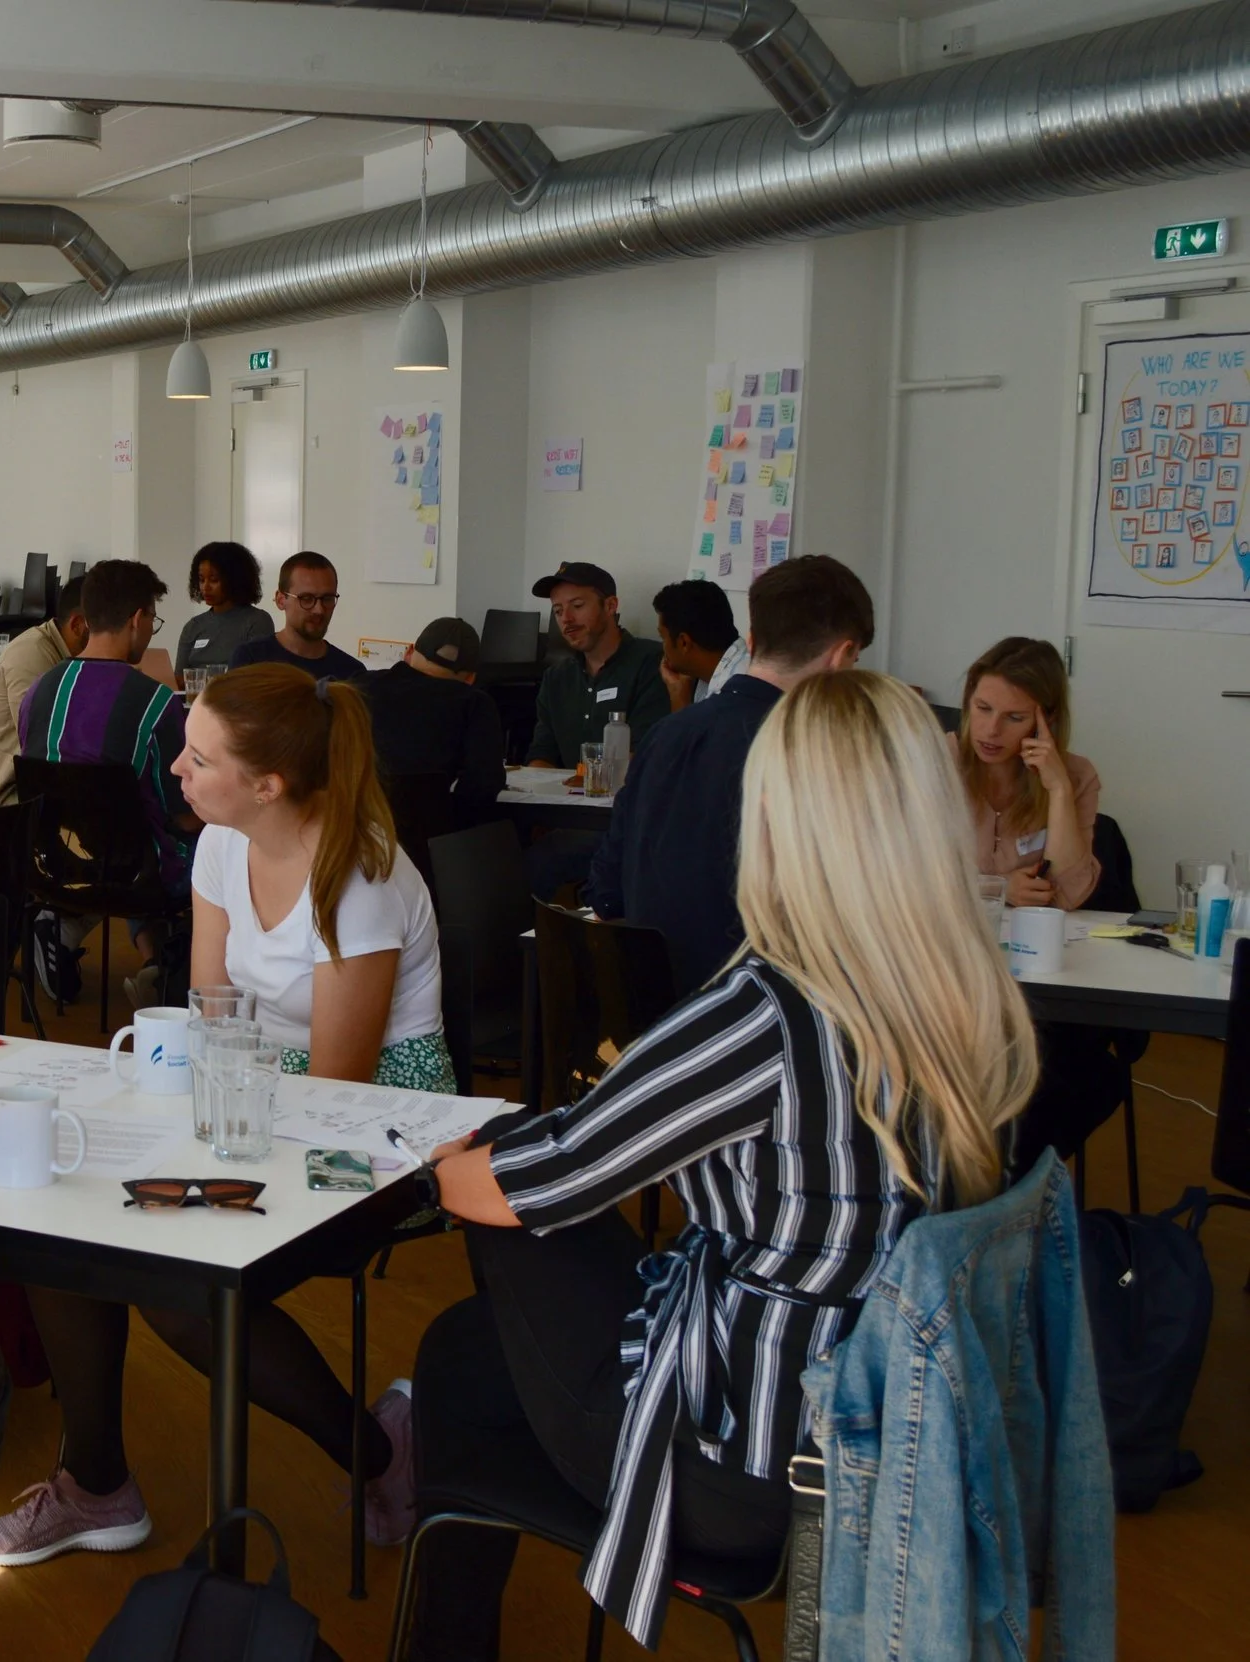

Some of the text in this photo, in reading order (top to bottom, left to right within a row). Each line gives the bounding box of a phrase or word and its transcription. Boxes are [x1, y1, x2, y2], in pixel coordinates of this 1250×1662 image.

[1142, 350, 1245, 376] WHO ARE WE
